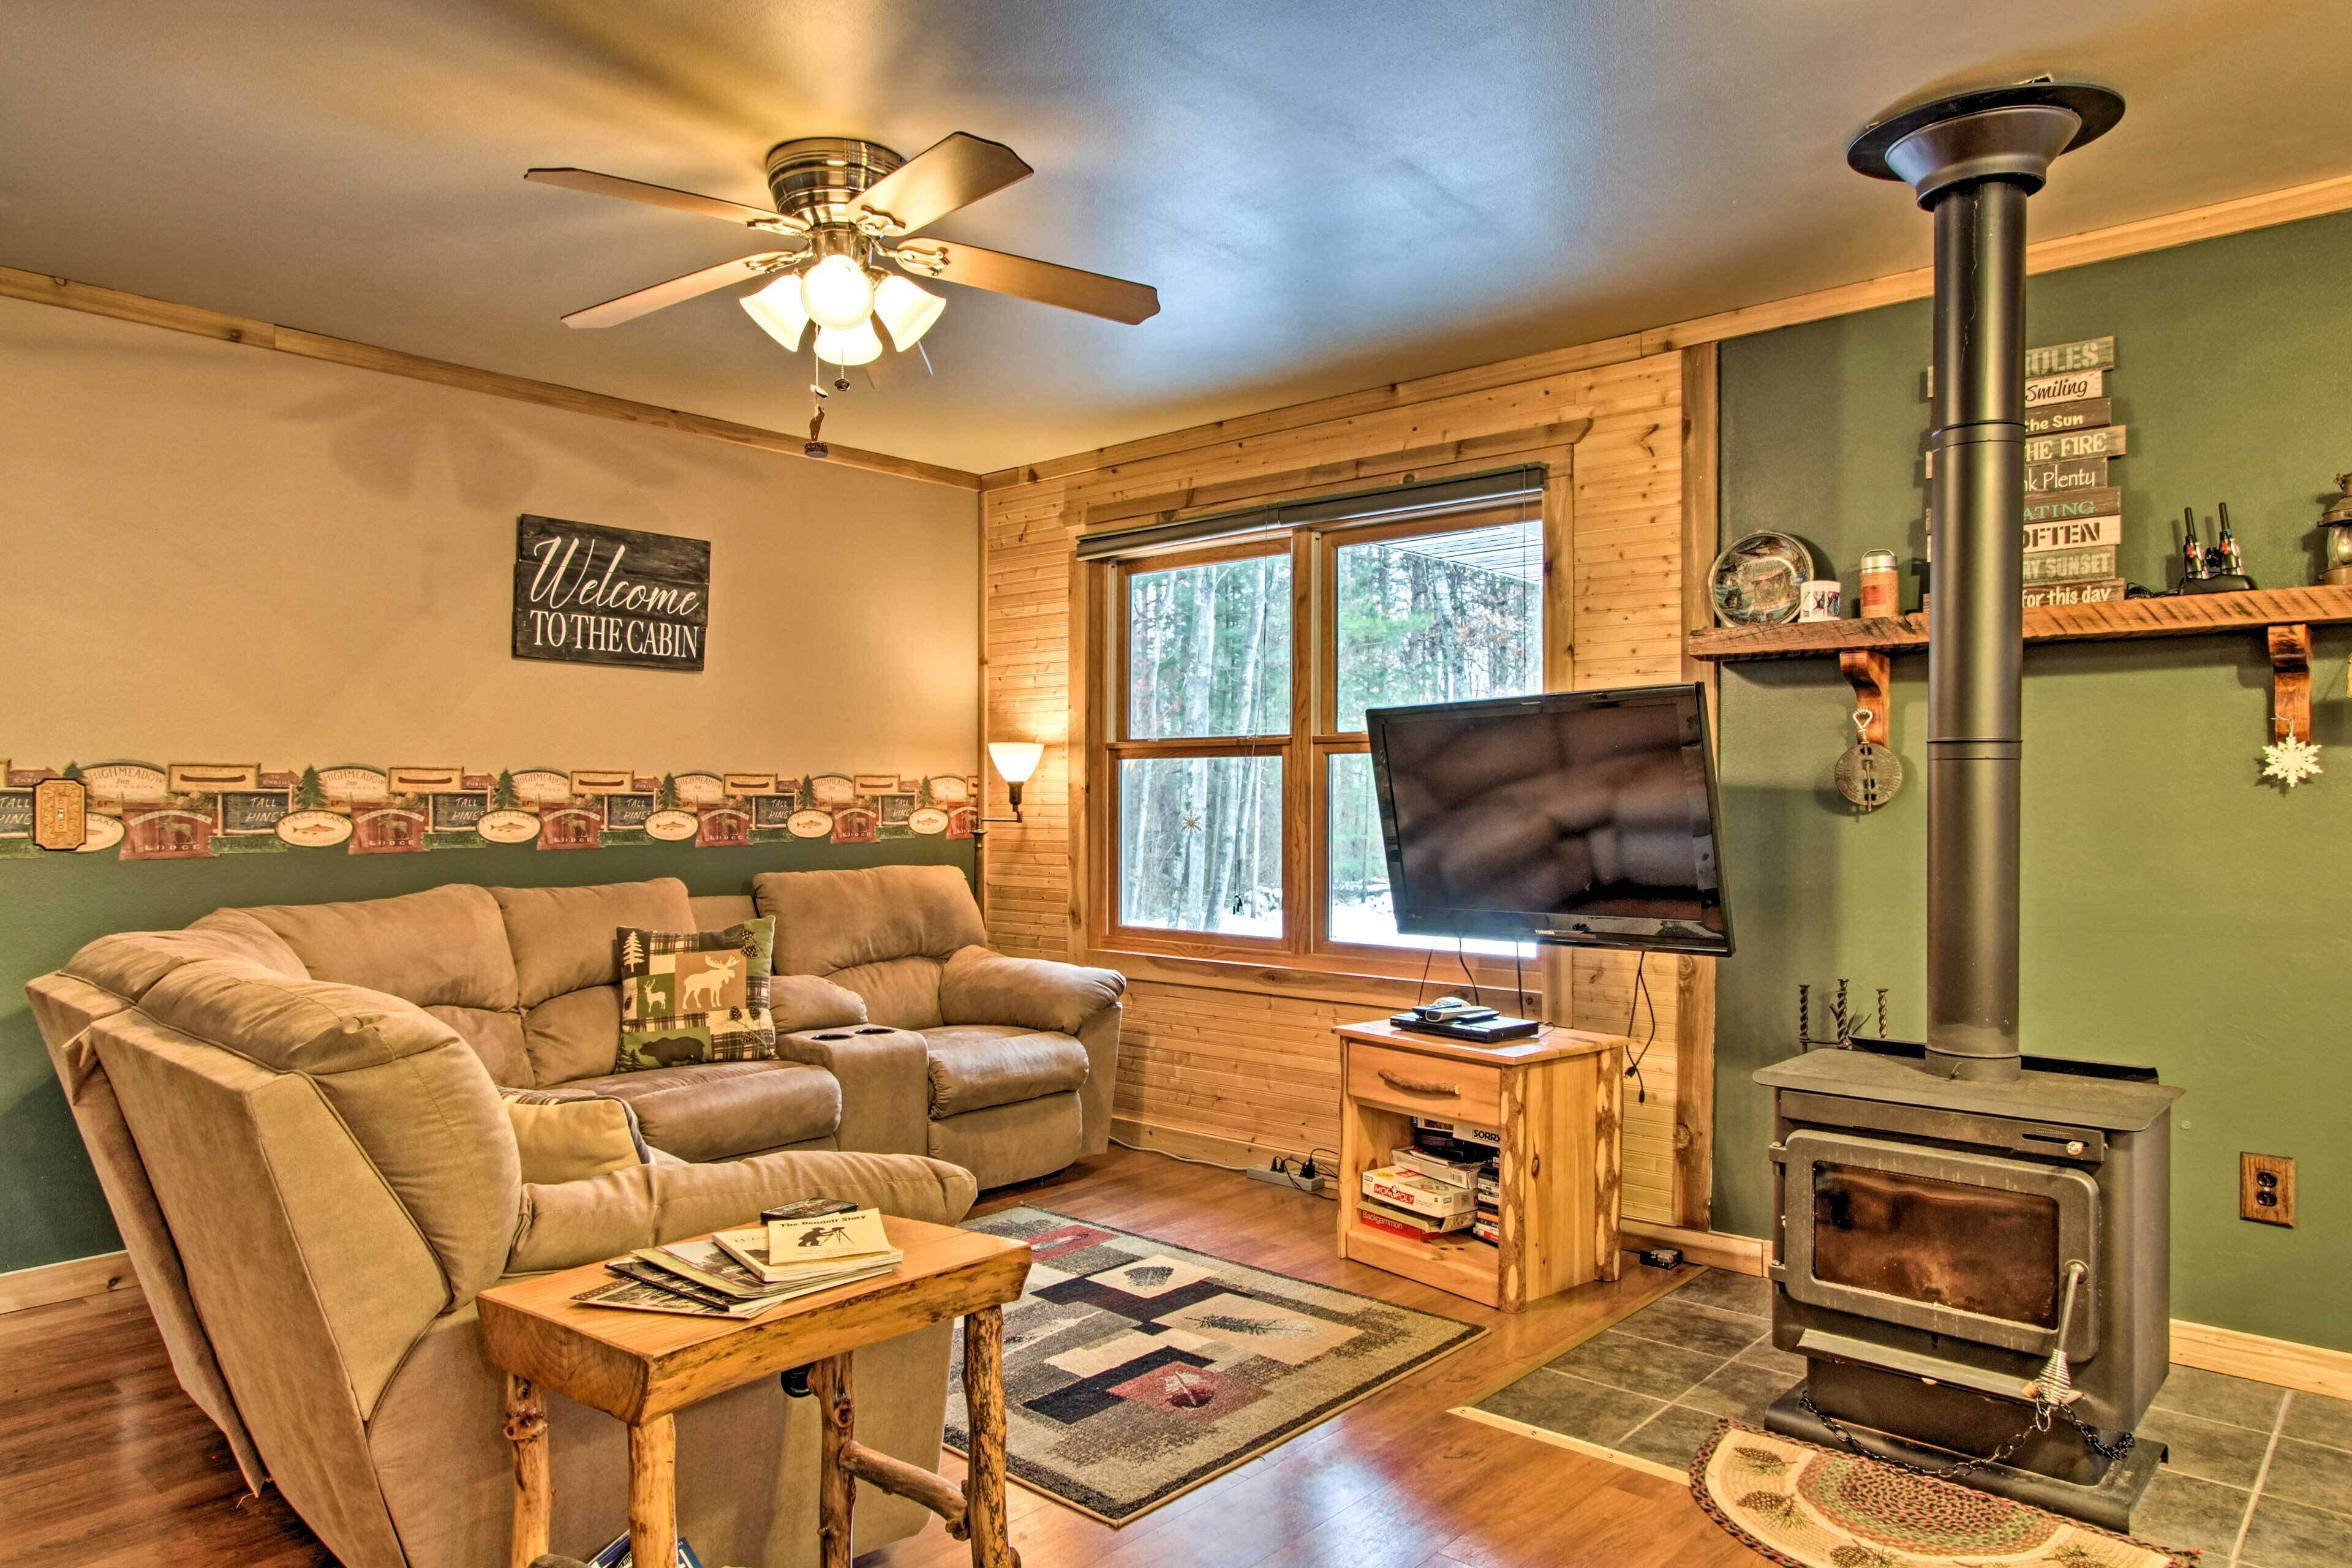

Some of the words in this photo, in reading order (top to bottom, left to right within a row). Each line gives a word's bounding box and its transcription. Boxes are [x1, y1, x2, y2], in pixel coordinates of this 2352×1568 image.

[2026, 379, 2087, 402] Smiling
[2052, 415, 2083, 428] Sun
[2025, 441, 2052, 461] HE
[2060, 433, 2106, 457] FIRE
[2043, 464, 2095, 489] Plenty
[2046, 553, 2111, 578] SUNSET
[530, 536, 699, 616] Welcome
[2047, 587, 2078, 606] this
[2082, 585, 2112, 603] day
[530, 610, 567, 647] TO
[570, 614, 623, 652] THE
[627, 620, 699, 659] CABIN
[0, 797, 29, 808] TALL
[251, 797, 276, 807] TALL
[456, 797, 477, 807] TALL
[627, 798, 645, 808] TALL
[771, 799, 788, 807] TALL
[324, 812, 347, 825] LAKE
[1374, 1185, 1414, 1204] MONOPOLY
[1363, 1210, 1403, 1230] Backgammon
